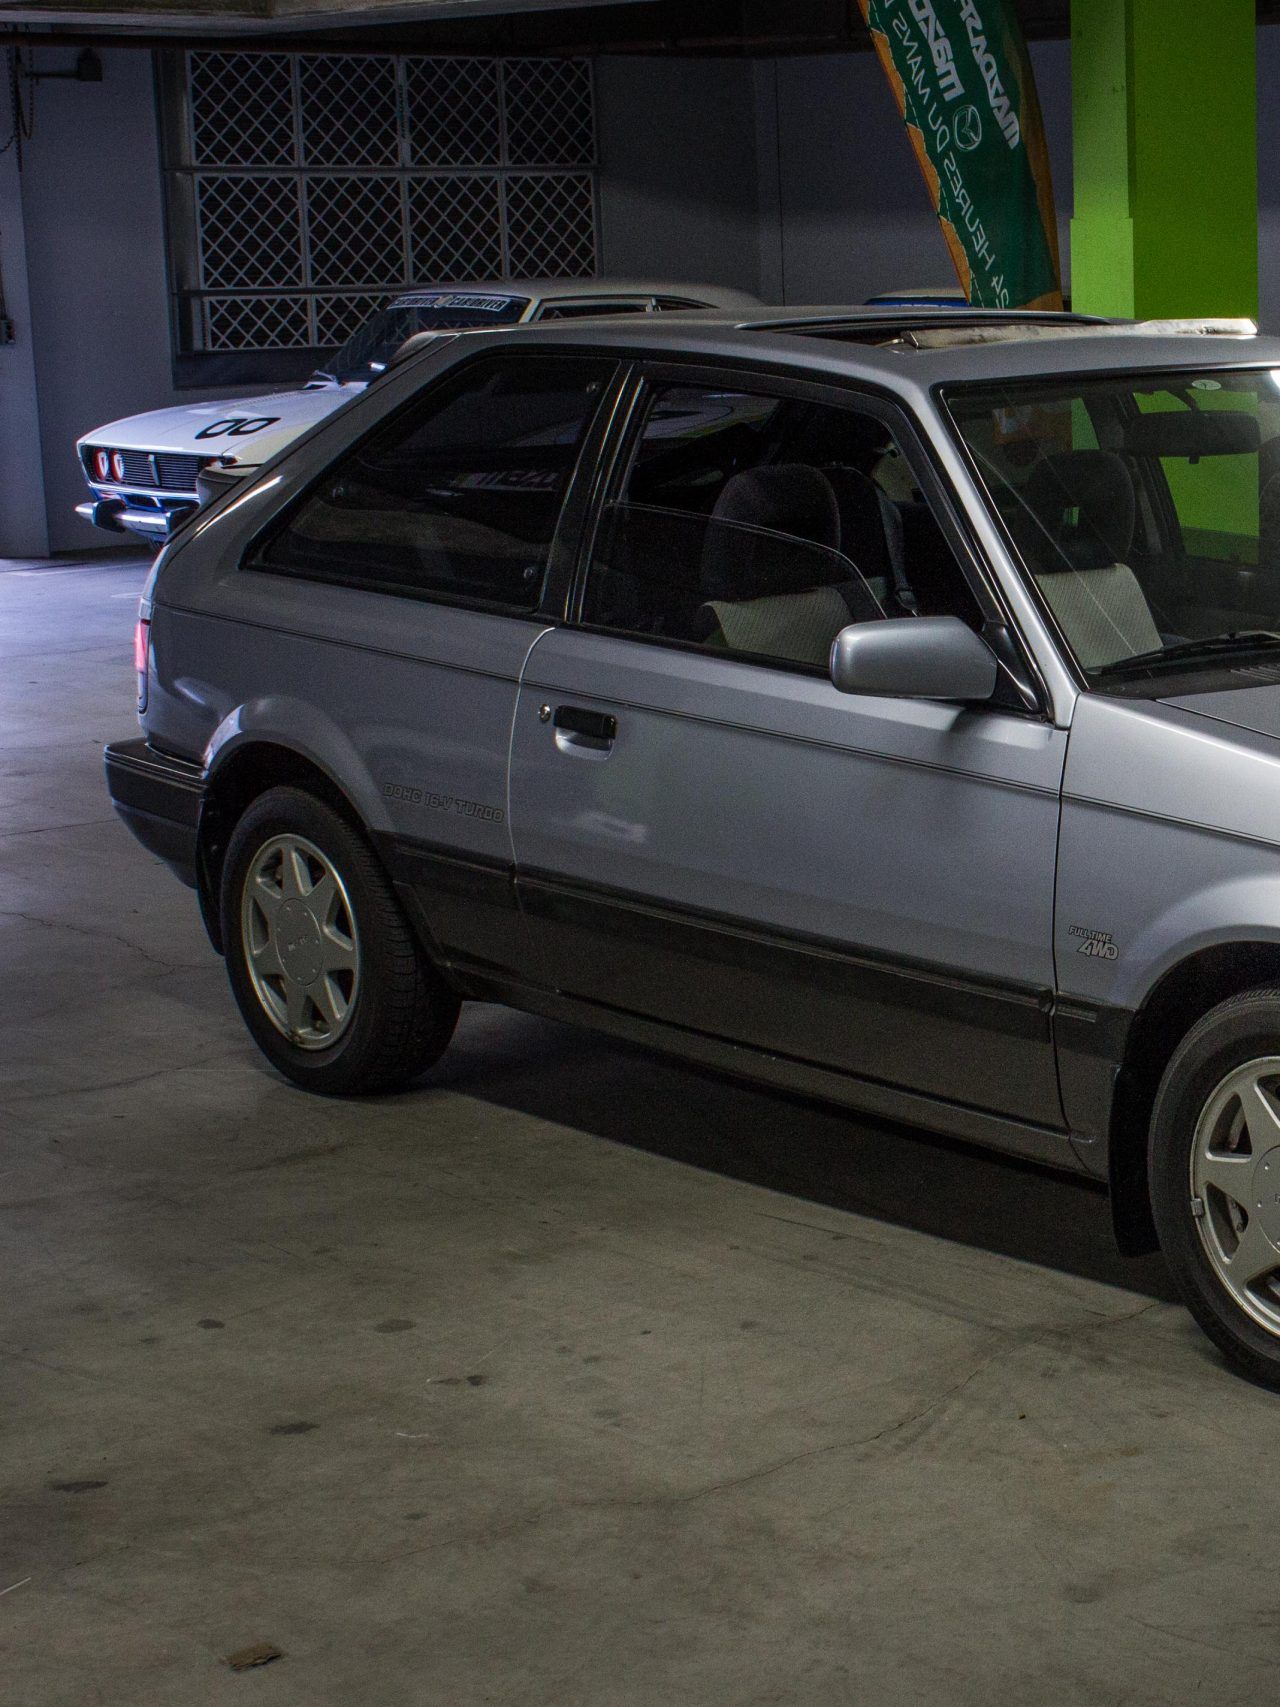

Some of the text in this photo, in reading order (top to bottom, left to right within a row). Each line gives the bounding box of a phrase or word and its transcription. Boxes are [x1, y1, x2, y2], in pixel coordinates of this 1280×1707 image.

[195, 417, 281, 439] 00
[383, 782, 422, 803] DOHC
[455, 800, 505, 823] TURBO
[1076, 938, 1119, 960] 4WD
